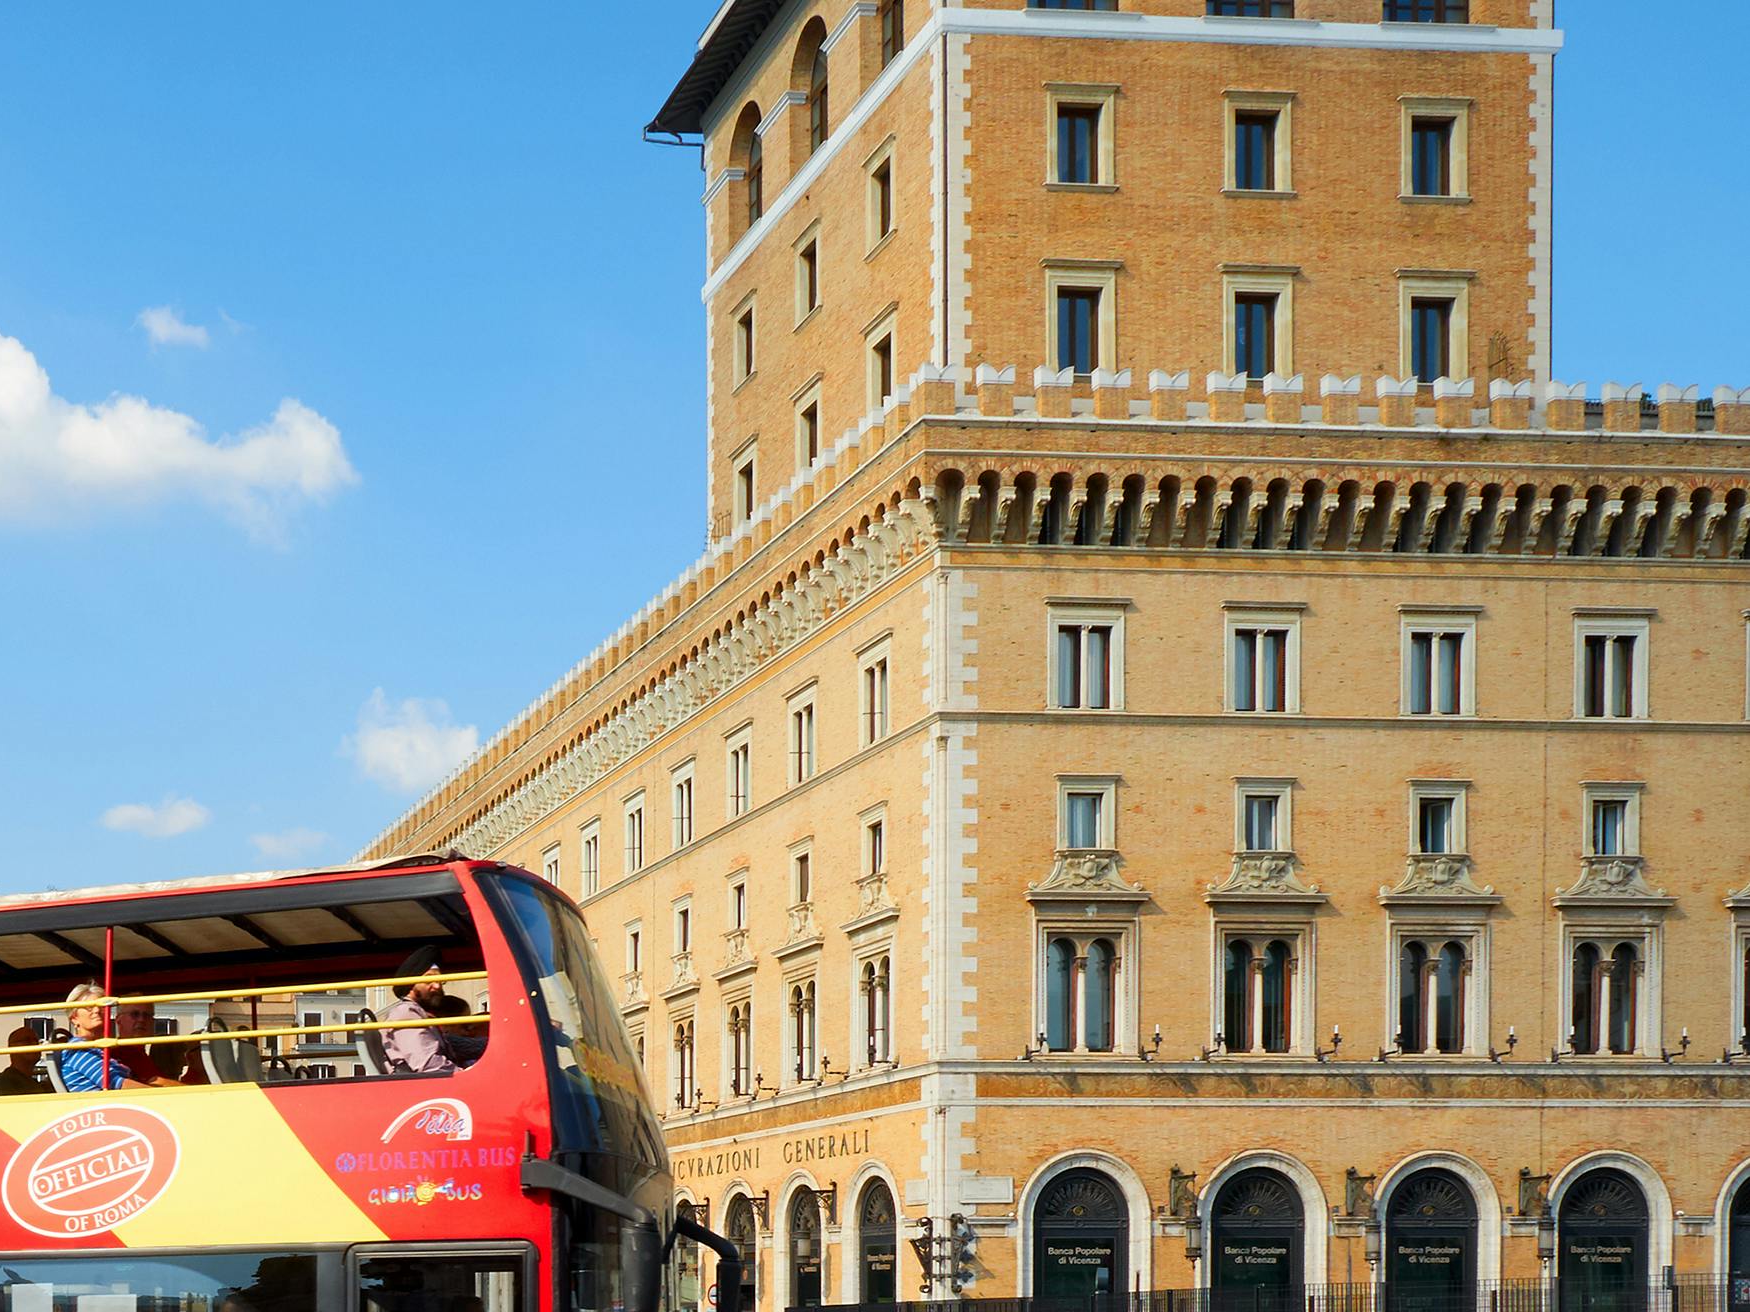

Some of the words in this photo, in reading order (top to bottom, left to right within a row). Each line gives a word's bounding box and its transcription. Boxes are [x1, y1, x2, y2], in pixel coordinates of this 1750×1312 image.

[50, 1111, 107, 1139] TOUR
[33, 1145, 148, 1197] OFFICIAL
[356, 1149, 473, 1172] FLORENTIA
[477, 1146, 516, 1167] BUS
[672, 1147, 760, 1180] ICVRAZIONI
[782, 1129, 870, 1164] GENERALI
[64, 1216, 91, 1232] OF
[93, 1193, 147, 1229] ROMA
[1047, 1247, 1074, 1255] Banca
[1075, 1246, 1111, 1256] Popolare
